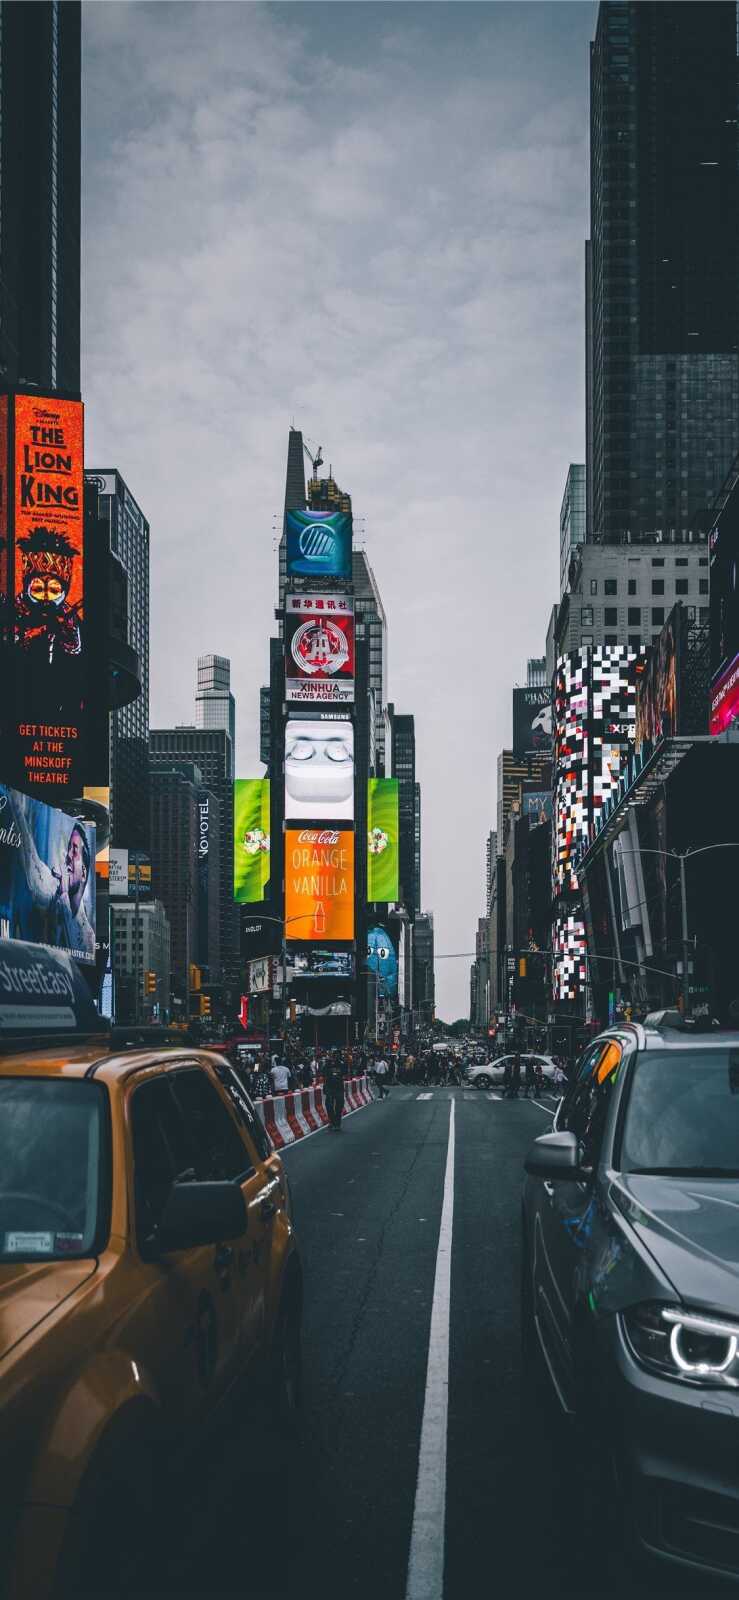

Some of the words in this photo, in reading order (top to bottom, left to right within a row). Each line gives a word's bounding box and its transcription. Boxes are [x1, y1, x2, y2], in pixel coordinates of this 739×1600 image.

[31, 425, 65, 446] THE
[24, 444, 72, 473] LION
[21, 474, 79, 508] KING
[291, 691, 315, 699] NEWS
[316, 692, 349, 700] AGENCY
[300, 682, 340, 692] XINHUA
[19, 724, 36, 737] GET
[39, 725, 78, 739] TICKETS
[32, 741, 44, 751] AT
[47, 741, 64, 753] THE
[24, 755, 72, 769] MINSKOFF
[29, 771, 69, 784] THEATRE
[198, 798, 209, 859] NOVOTEL
[292, 848, 346, 869] ORANGE
[293, 875, 347, 896] VANILLA
[0, 960, 75, 1004] StreetEasy
